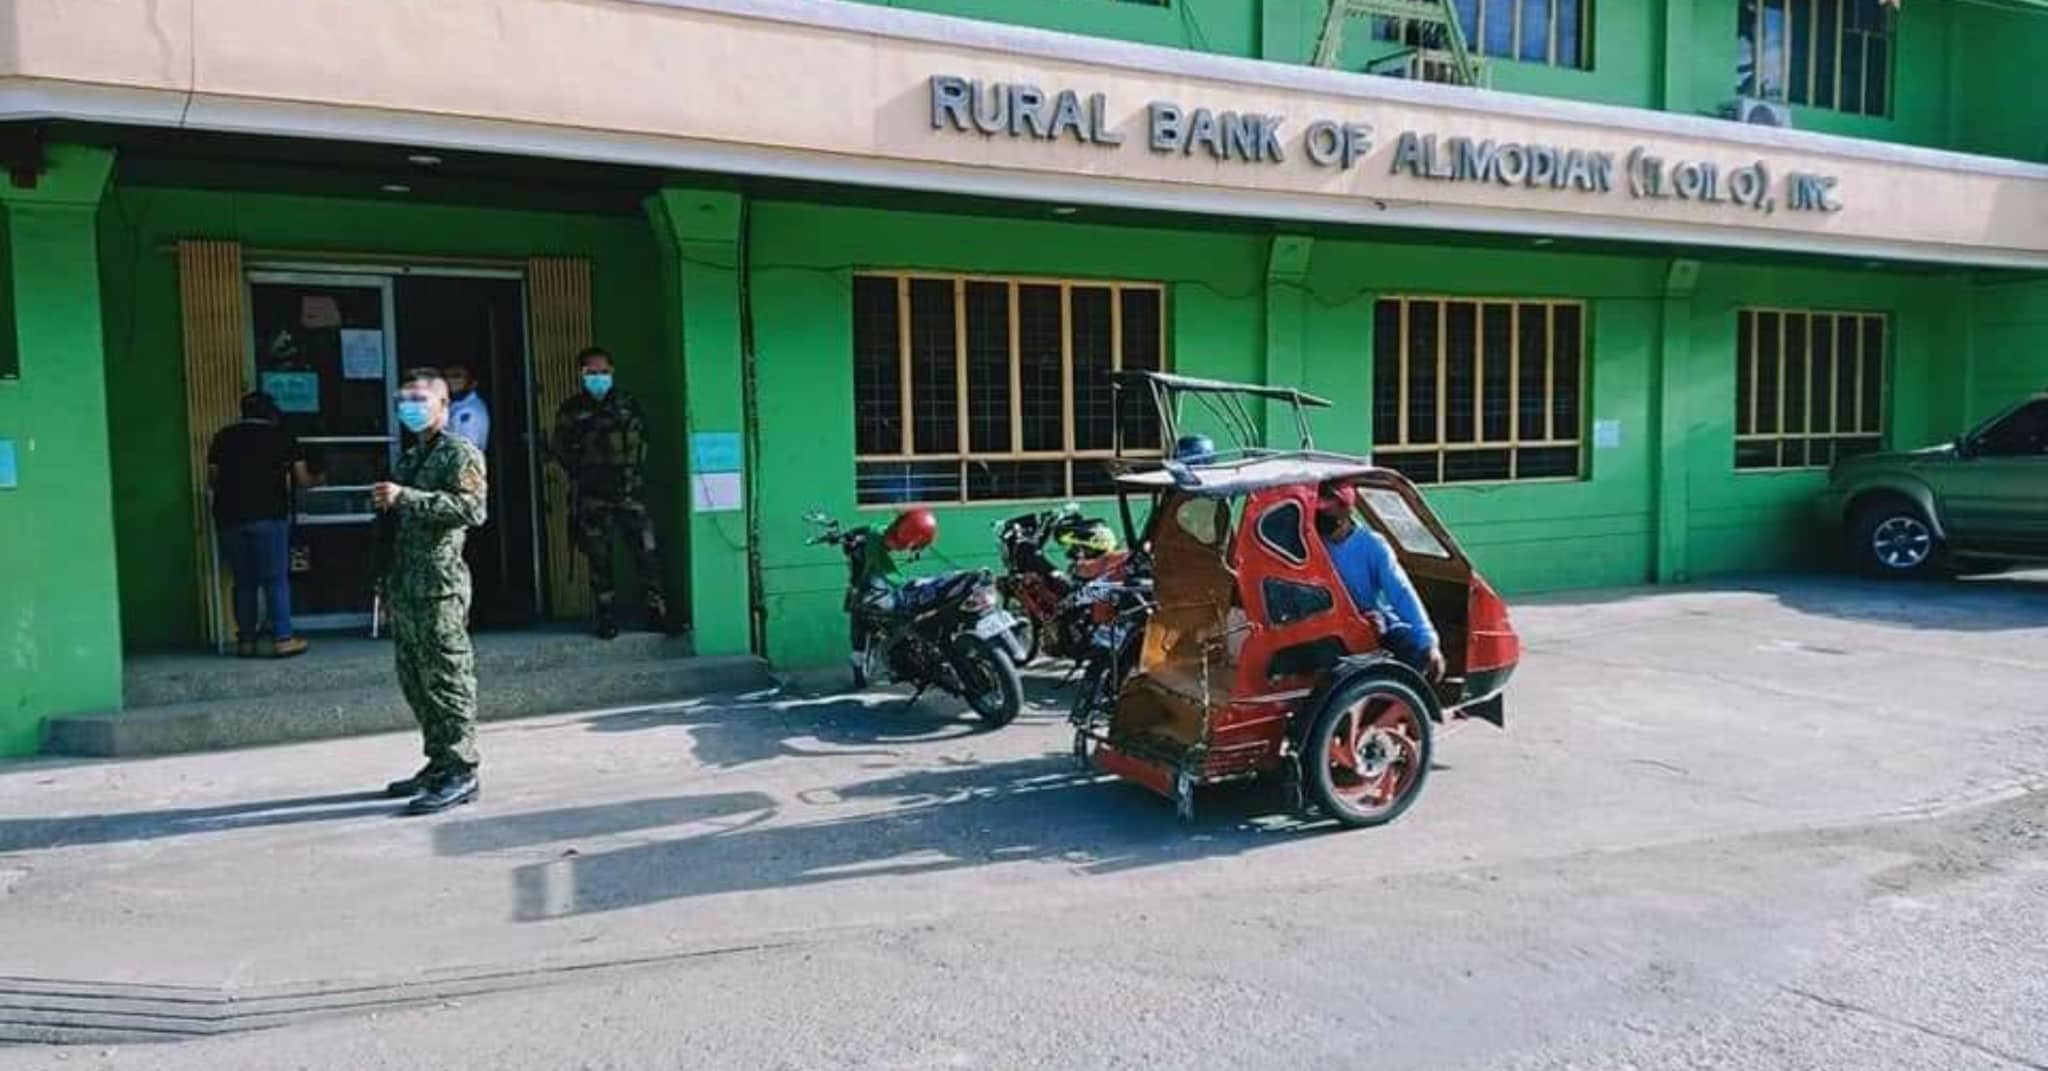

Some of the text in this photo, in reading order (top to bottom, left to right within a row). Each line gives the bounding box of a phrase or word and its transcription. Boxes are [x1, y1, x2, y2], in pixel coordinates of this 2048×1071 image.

[930, 74, 1124, 146] RURAL
[1148, 101, 1284, 163] BANK
[1305, 119, 1375, 170] OF
[1390, 130, 1617, 193] ALIMODIAN
